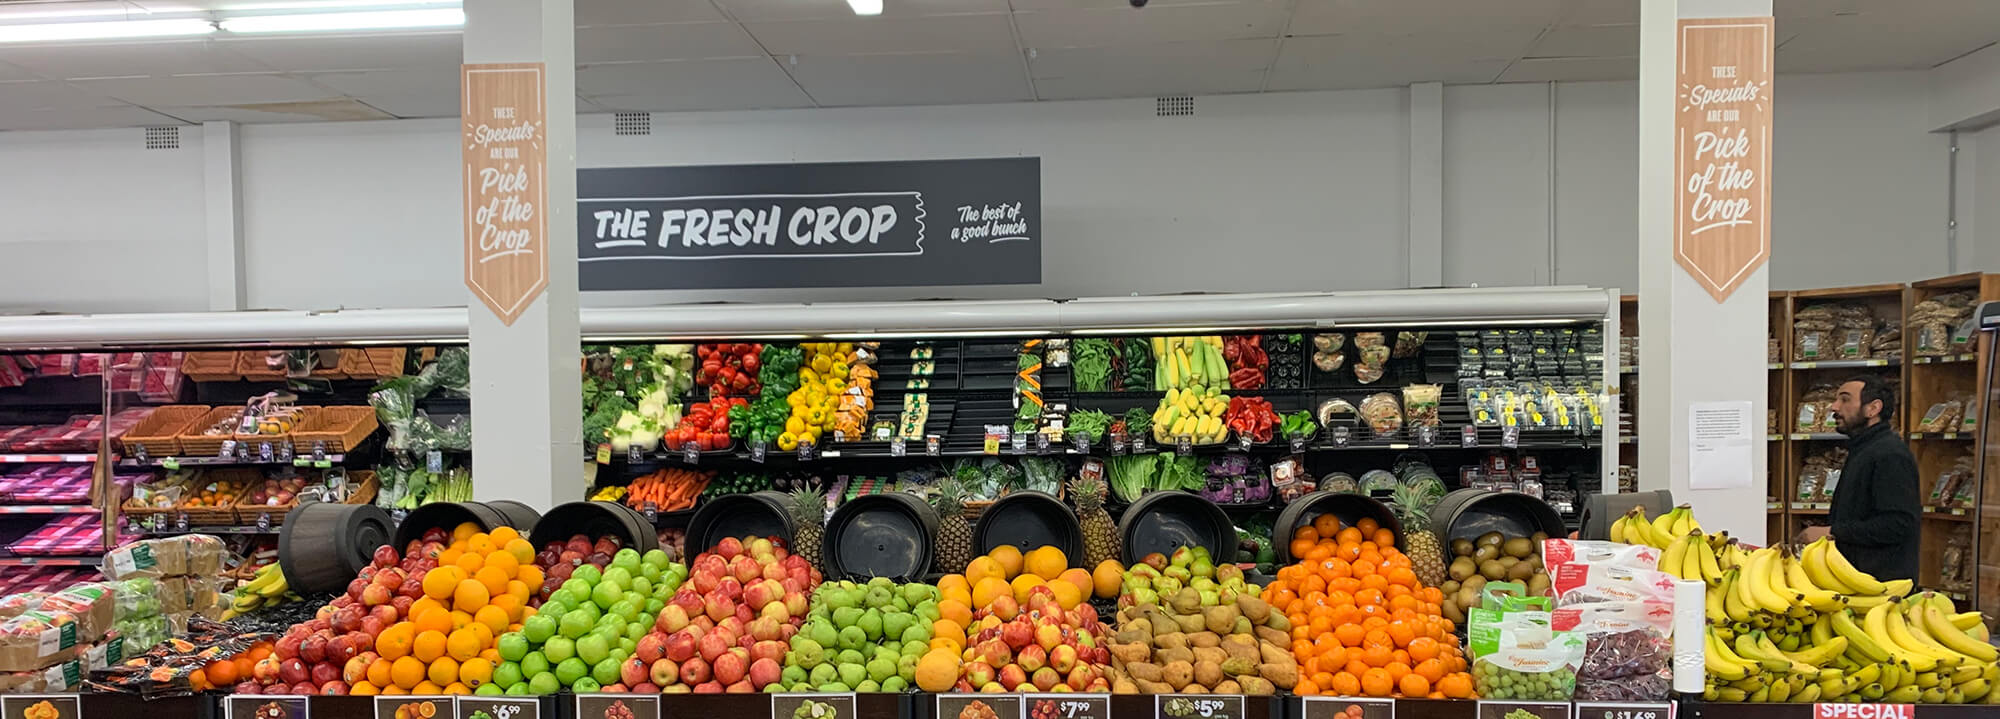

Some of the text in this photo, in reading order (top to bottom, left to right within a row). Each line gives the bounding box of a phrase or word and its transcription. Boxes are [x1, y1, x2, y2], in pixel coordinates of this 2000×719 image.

[1712, 66, 1736, 78] THESE
[1690, 80, 1760, 110] Specials
[493, 107, 515, 119] THESE
[1706, 110, 1739, 122] ARE OUR
[475, 120, 535, 148] Specials
[1694, 126, 1750, 160] Pick
[490, 147, 518, 159] ARE OUR
[480, 163, 528, 195] Pick
[1688, 161, 1755, 196] of the
[476, 195, 533, 228] of the
[957, 202, 1021, 223] The best of
[1692, 192, 1752, 227] Crop
[480, 223, 531, 256] Crop
[594, 205, 897, 248] THE FRESH CROP
[951, 218, 1027, 243] a good bunch
[1821, 703, 1908, 719] SPECIAL
